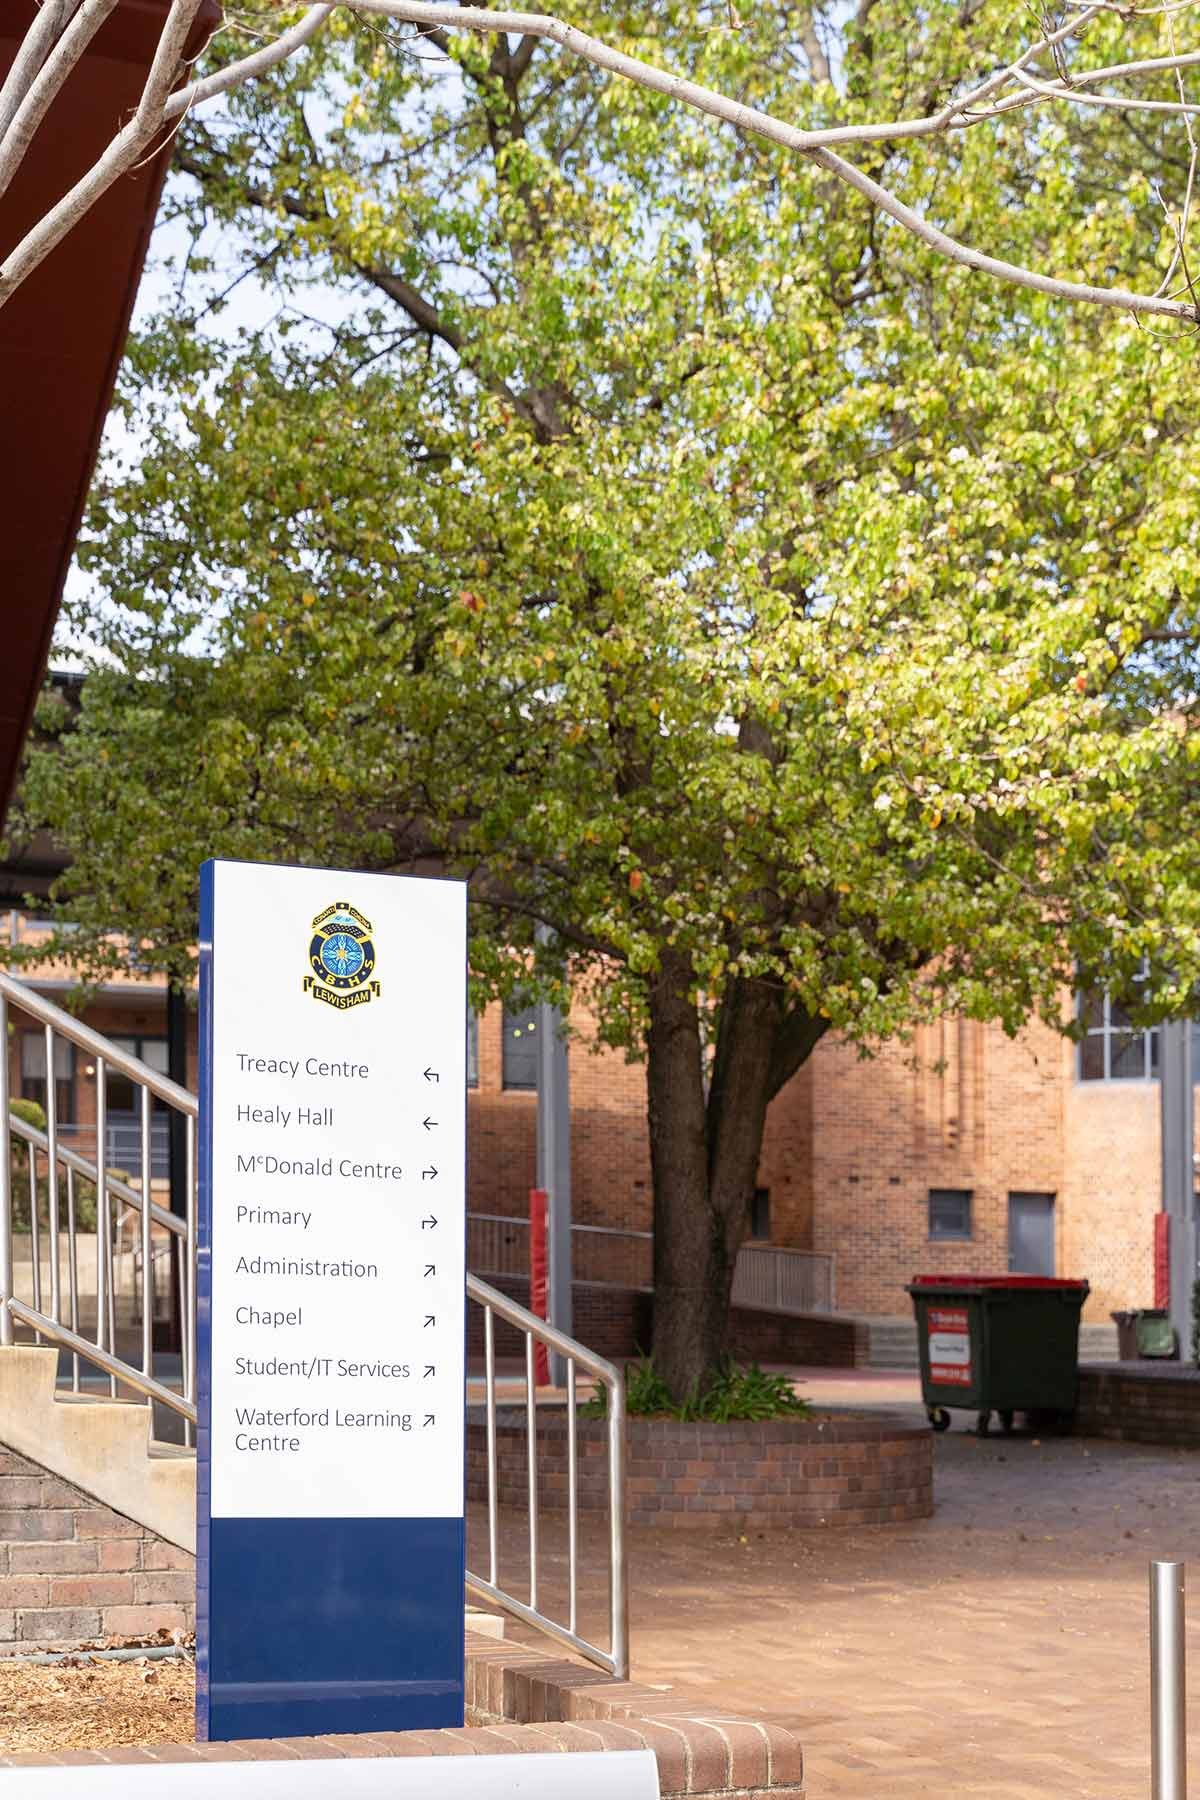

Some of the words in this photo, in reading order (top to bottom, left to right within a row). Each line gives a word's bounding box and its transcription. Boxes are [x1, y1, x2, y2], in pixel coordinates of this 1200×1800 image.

[315, 987, 369, 1009] LEWISHAM
[236, 1053, 299, 1079] Treacy
[305, 1057, 370, 1079] Centre
[236, 1104, 291, 1128] Healy
[298, 1107, 333, 1127] Hall
[236, 1154, 333, 1177] McDonald
[339, 1159, 403, 1180] Centre
[236, 1205, 312, 1230] Primary
[235, 1256, 378, 1278] Administration
[235, 1306, 302, 1329] Chapel
[235, 1357, 333, 1380] Student/IT
[337, 1358, 411, 1379] Services
[235, 1407, 329, 1427] Waterford
[335, 1409, 412, 1432] Learning
[235, 1433, 300, 1452] Centre
